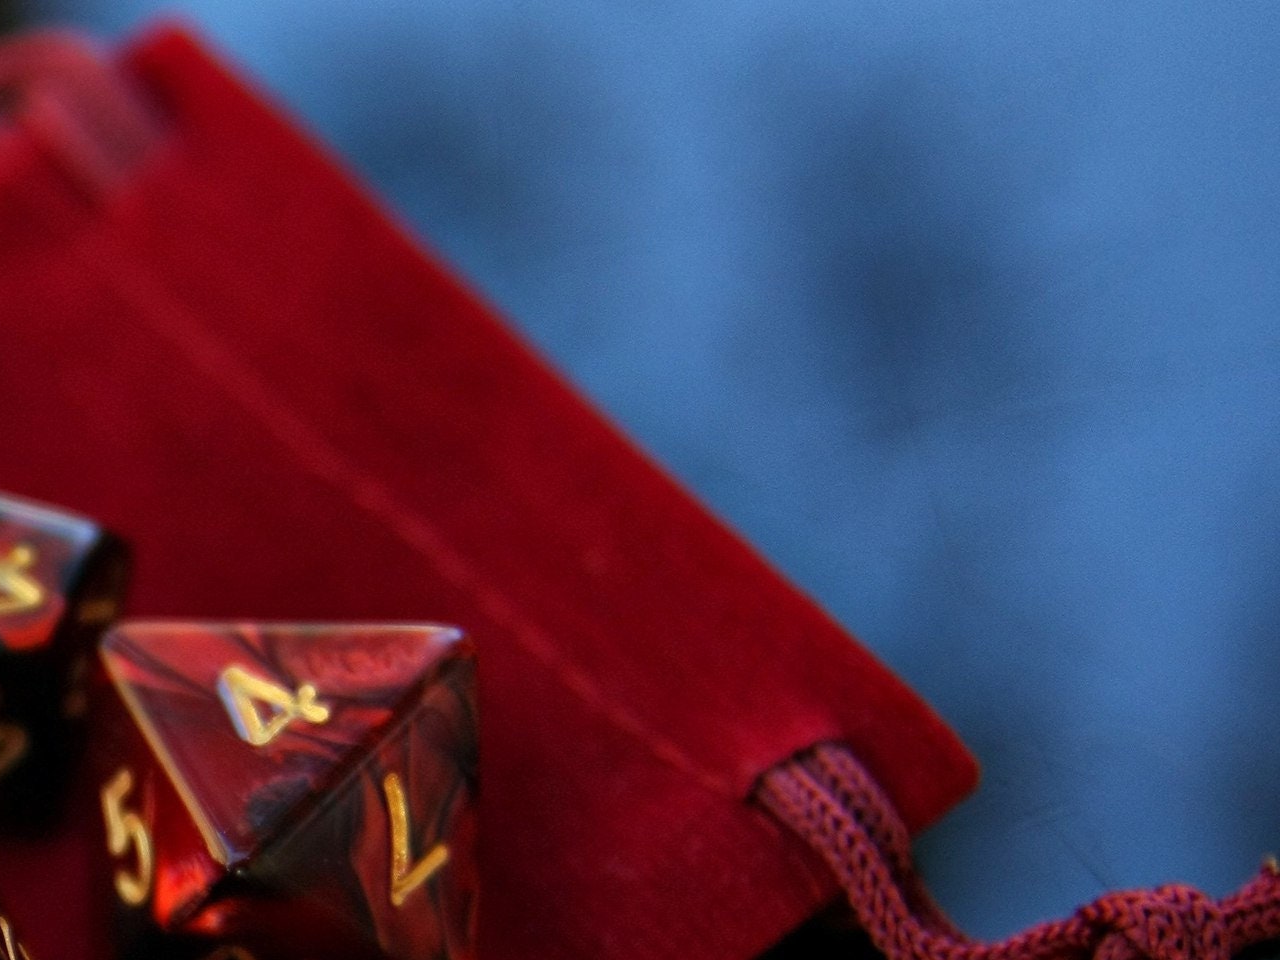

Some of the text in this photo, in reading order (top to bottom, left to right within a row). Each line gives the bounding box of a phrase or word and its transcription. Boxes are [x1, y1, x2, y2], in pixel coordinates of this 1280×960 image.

[218, 666, 329, 746] 4
[101, 769, 152, 906] 5
[383, 773, 449, 905] 7
